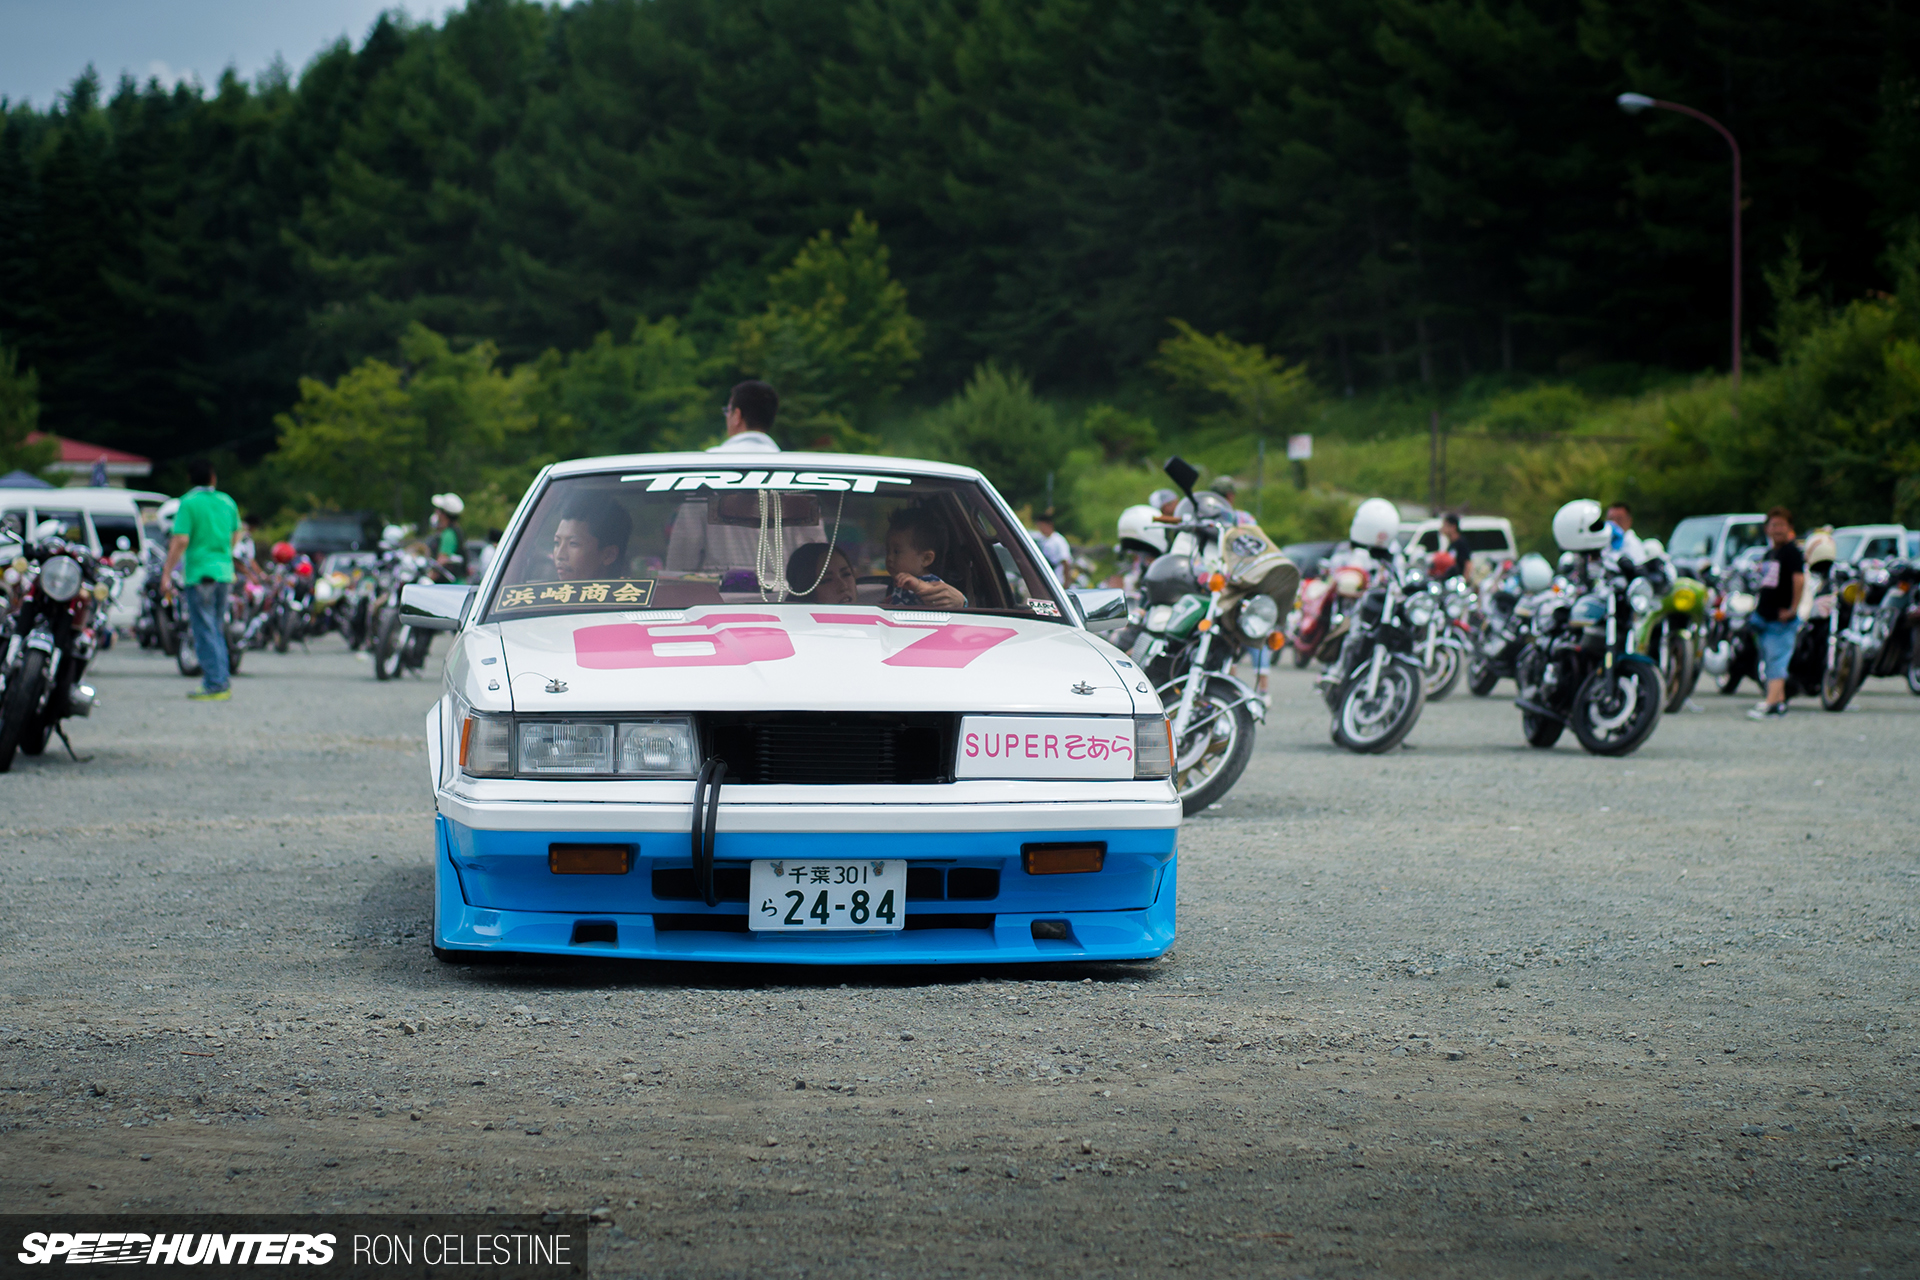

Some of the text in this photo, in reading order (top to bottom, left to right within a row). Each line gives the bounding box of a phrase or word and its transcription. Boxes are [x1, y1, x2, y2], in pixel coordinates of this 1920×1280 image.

[620, 471, 912, 493] TRUST
[502, 583, 646, 607] 浜崎商会
[784, 889, 896, 925] 24-84
